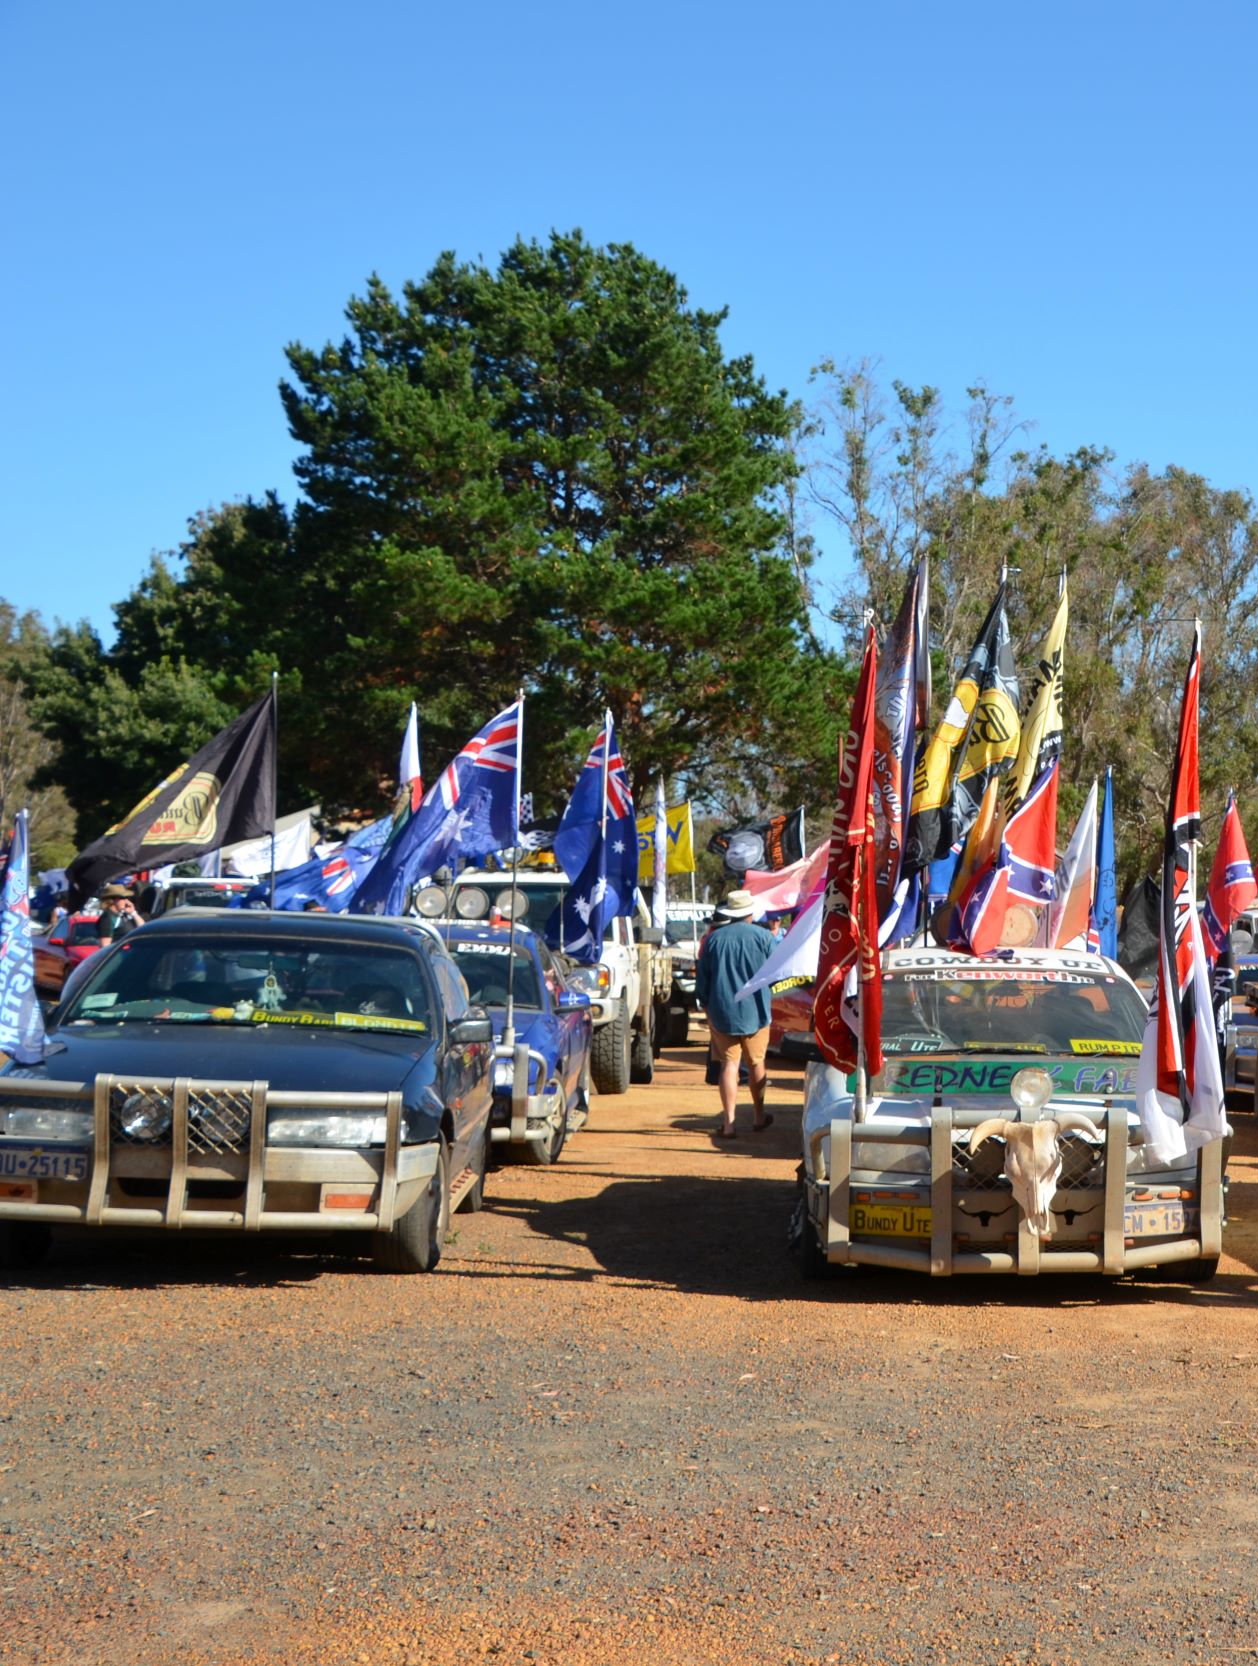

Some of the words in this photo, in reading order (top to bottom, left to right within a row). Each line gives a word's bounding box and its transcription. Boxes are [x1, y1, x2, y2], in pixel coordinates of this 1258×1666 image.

[886, 1065, 1061, 1089] REDNE
[854, 1209, 898, 1232] BUNDY
[903, 1211, 931, 1233] UTE
